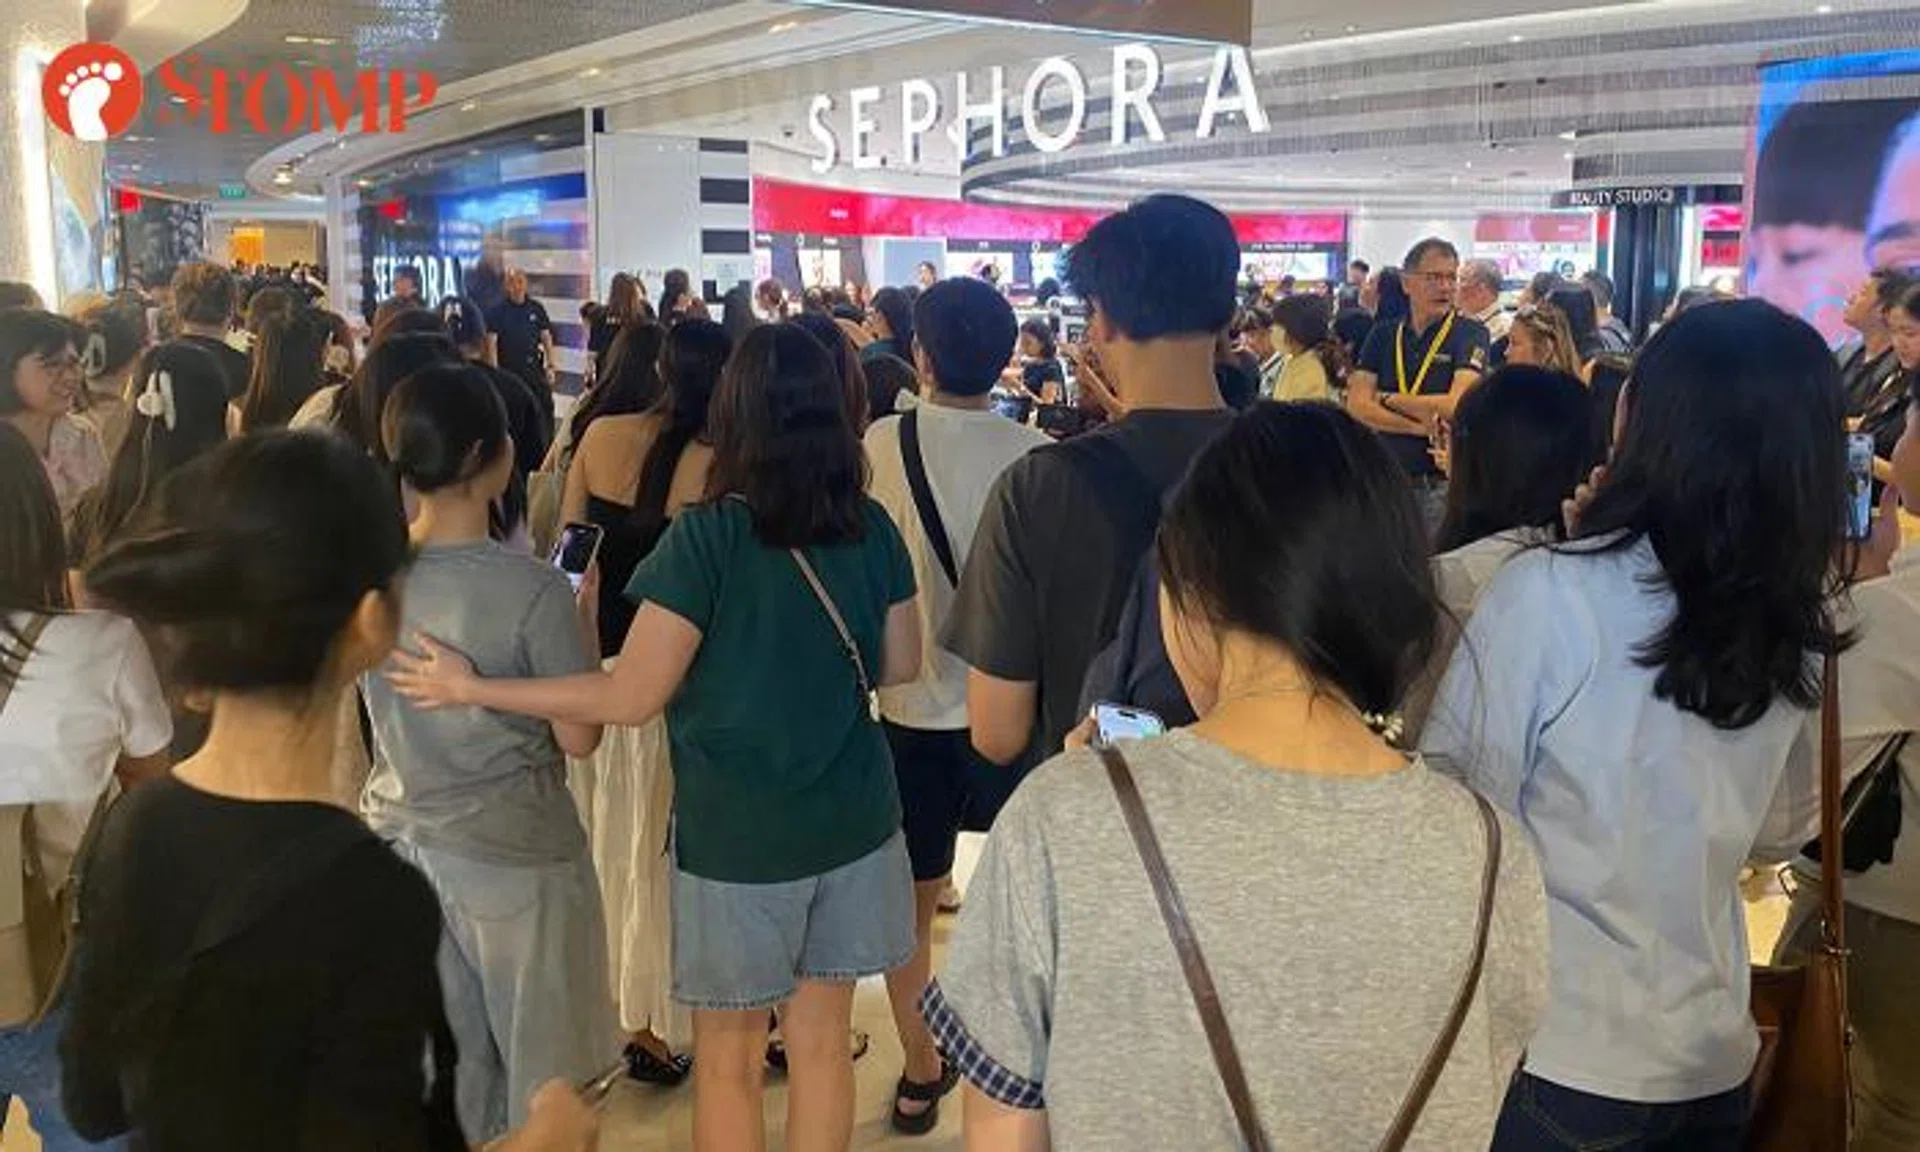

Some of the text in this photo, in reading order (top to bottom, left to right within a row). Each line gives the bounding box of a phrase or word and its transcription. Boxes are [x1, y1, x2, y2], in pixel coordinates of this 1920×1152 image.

[809, 43, 1271, 173] SEPHORA
[1615, 189, 1674, 204] STUDIO
[373, 256, 459, 308] SEORA
